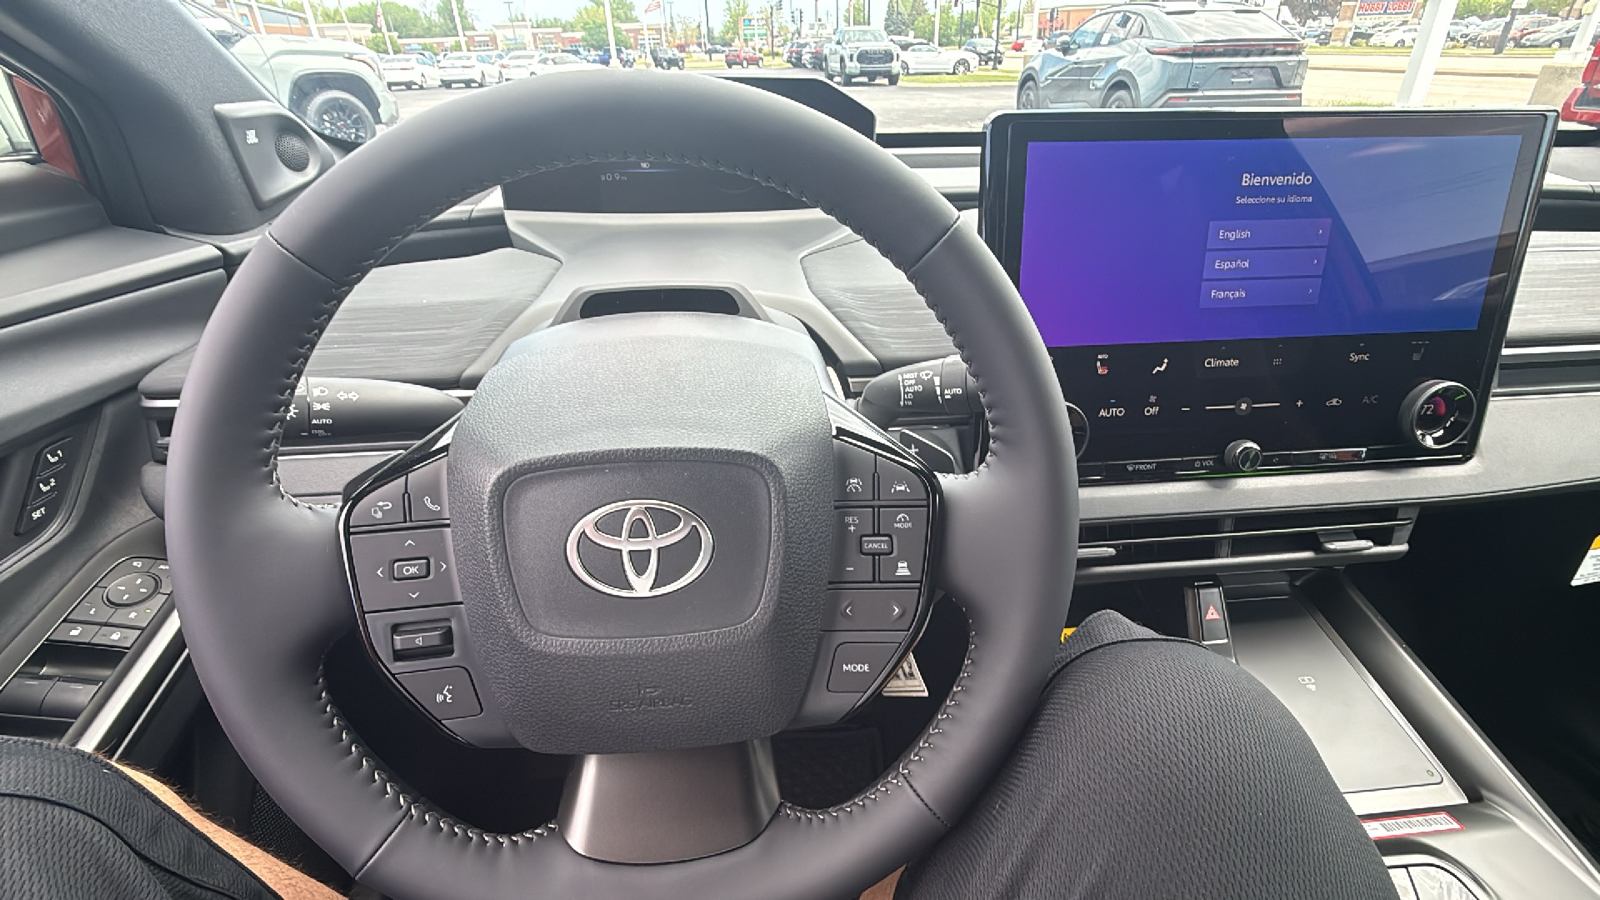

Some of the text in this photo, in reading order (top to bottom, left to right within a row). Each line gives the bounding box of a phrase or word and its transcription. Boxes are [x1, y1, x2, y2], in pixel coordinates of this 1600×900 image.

[1358, 0, 1414, 13] HOBBY LOBBY
[1241, 172, 1313, 187] Bienvenido
[1235, 194, 1313, 204] Seleccione su idioma
[1218, 229, 1251, 241] English
[1214, 259, 1250, 271] Español
[1210, 288, 1246, 300] Français
[1349, 352, 1370, 362] Sync
[1204, 358, 1240, 368] Climate
[905, 385, 923, 393] AUTO
[944, 387, 963, 395] AUTO
[1362, 395, 1379, 404] A/C
[1098, 407, 1126, 418] AUTO
[1144, 406, 1160, 416] Off
[1420, 404, 1435, 416] 72
[1134, 463, 1157, 471] FRONT
[31, 506, 46, 521] SET
[844, 516, 859, 524] RES
[402, 565, 419, 576] OK
[842, 663, 870, 673] MODE
